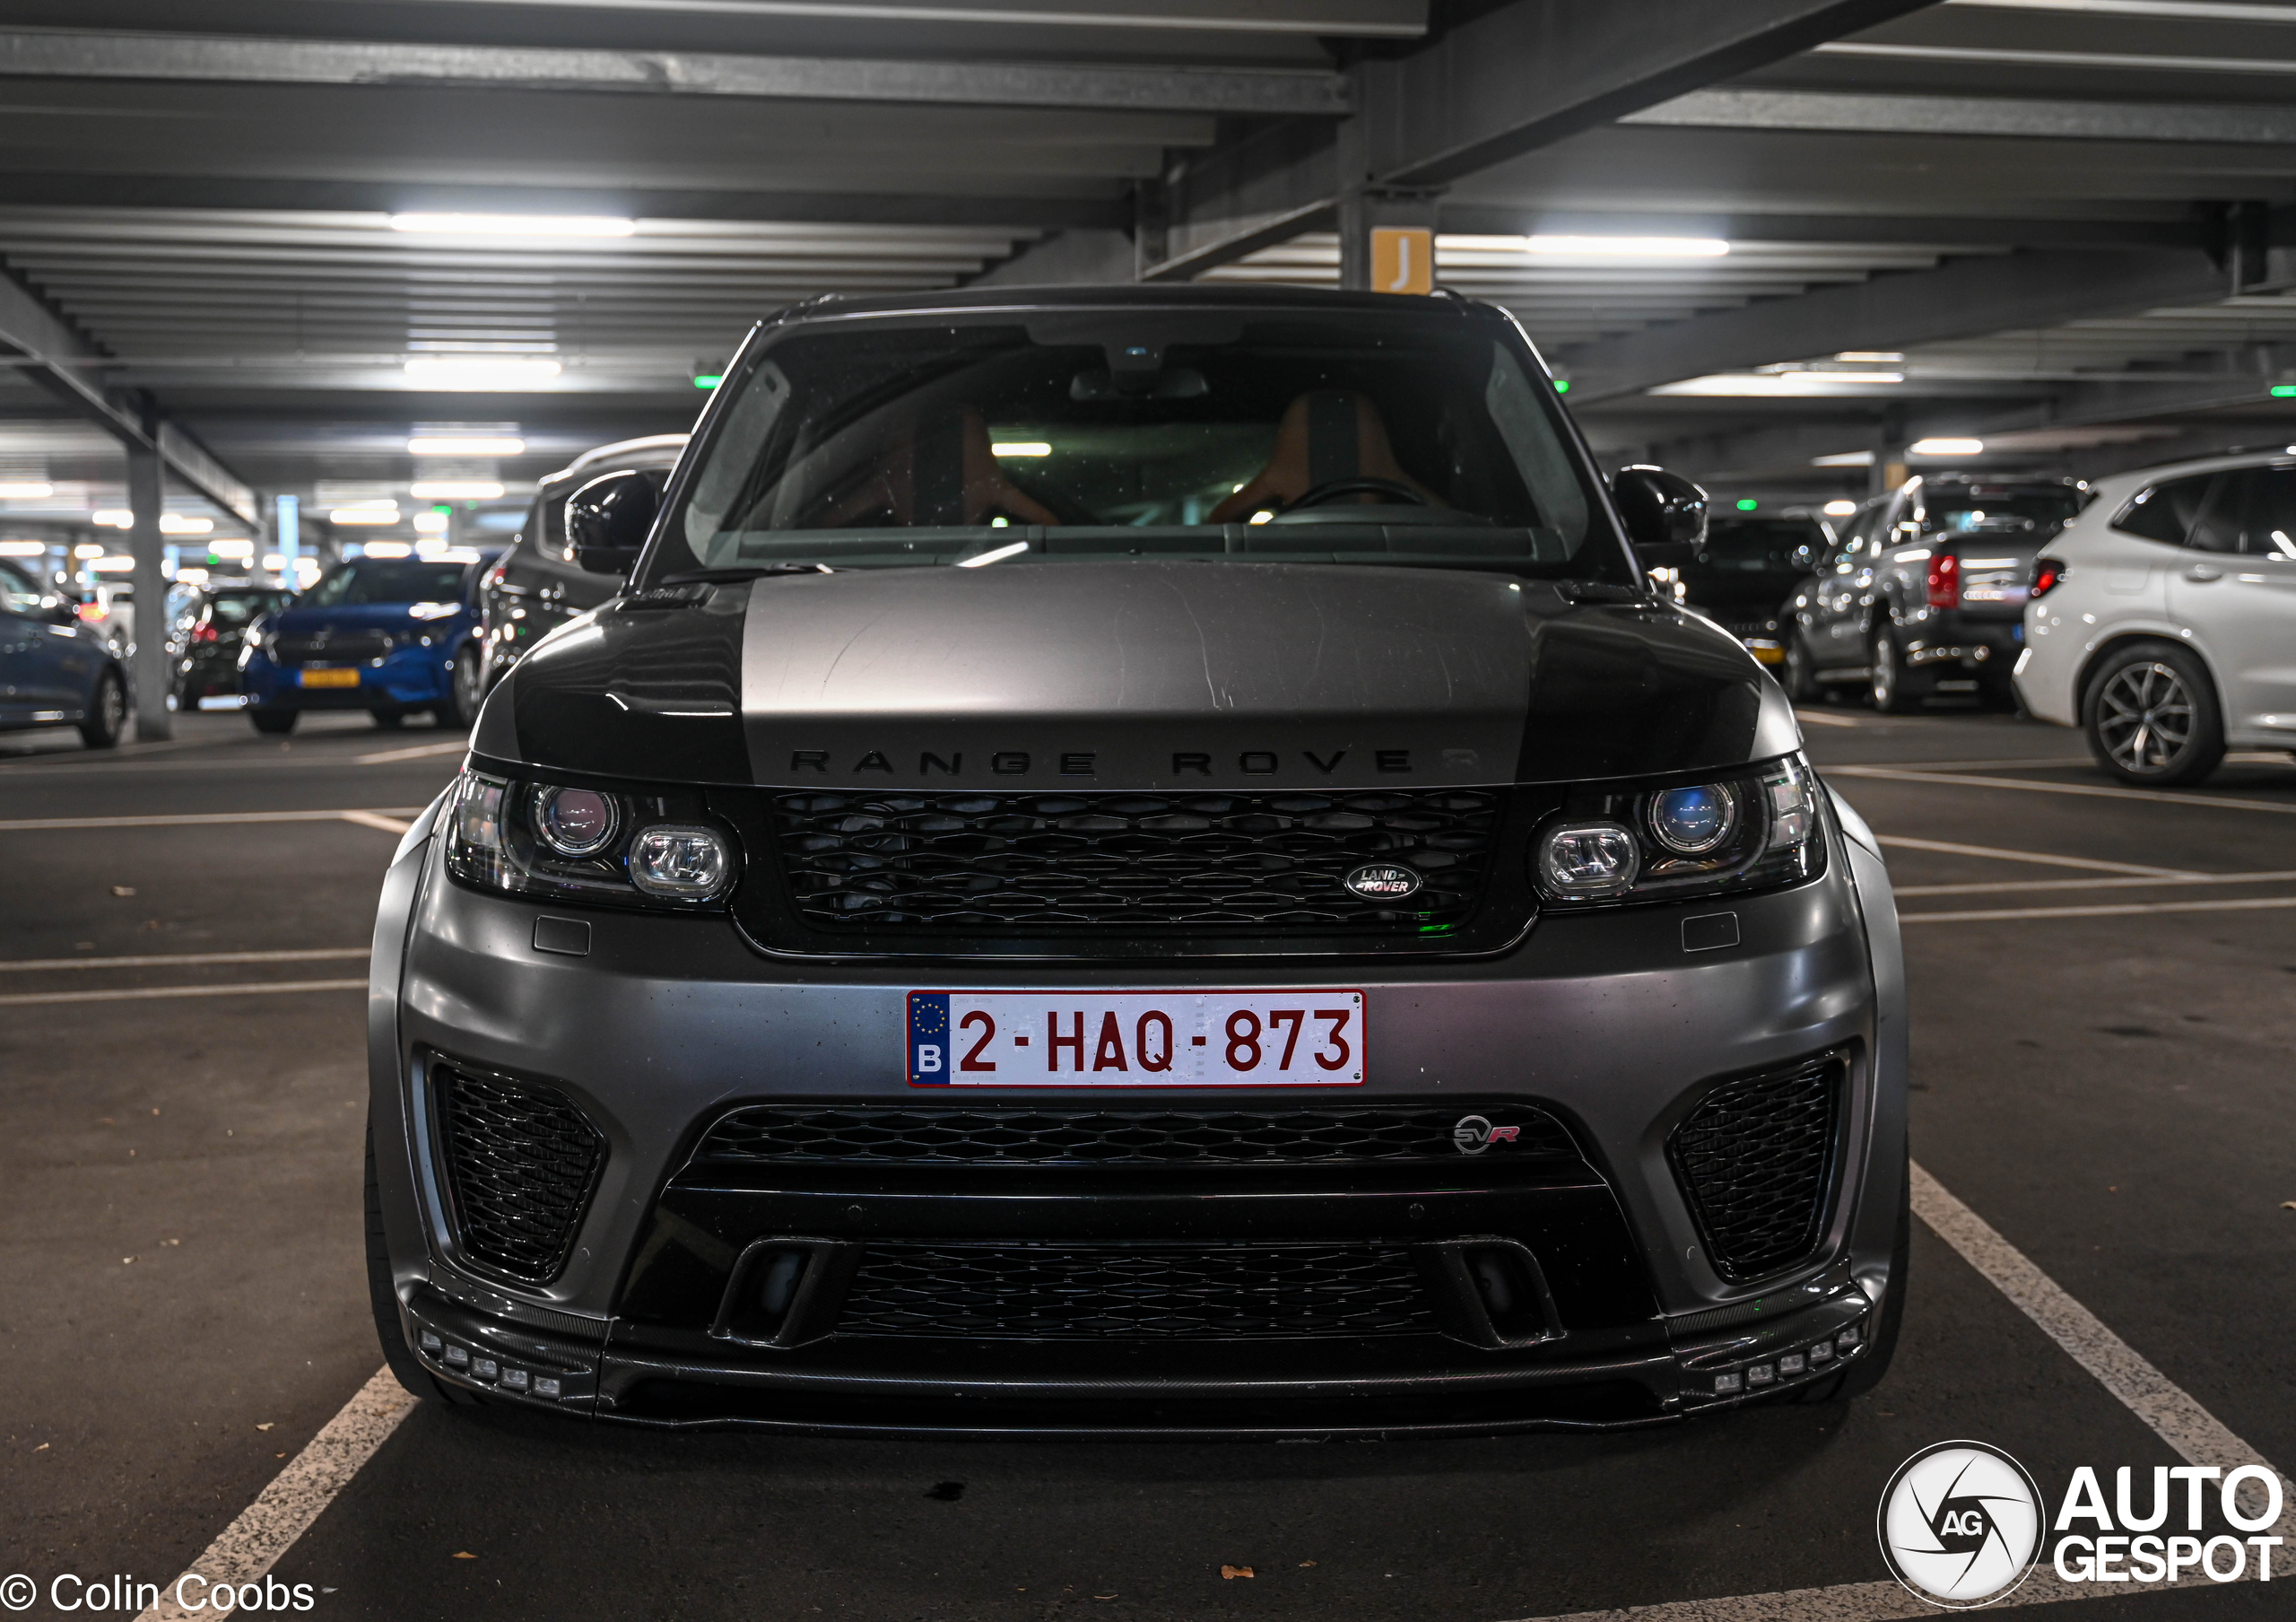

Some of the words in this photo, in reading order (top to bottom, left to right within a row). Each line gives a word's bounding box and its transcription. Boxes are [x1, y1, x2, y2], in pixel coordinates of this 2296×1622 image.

[1390, 236, 1409, 292] J
[790, 749, 1097, 776] RANGE
[1669, 837, 1689, 846] RANGE
[1361, 870, 1397, 880] LAND
[1363, 881, 1409, 892] ROVER
[959, 1009, 1351, 1072] 2-HAQ-873
[918, 1044, 942, 1072] B
[1454, 1124, 1520, 1144] SVR
